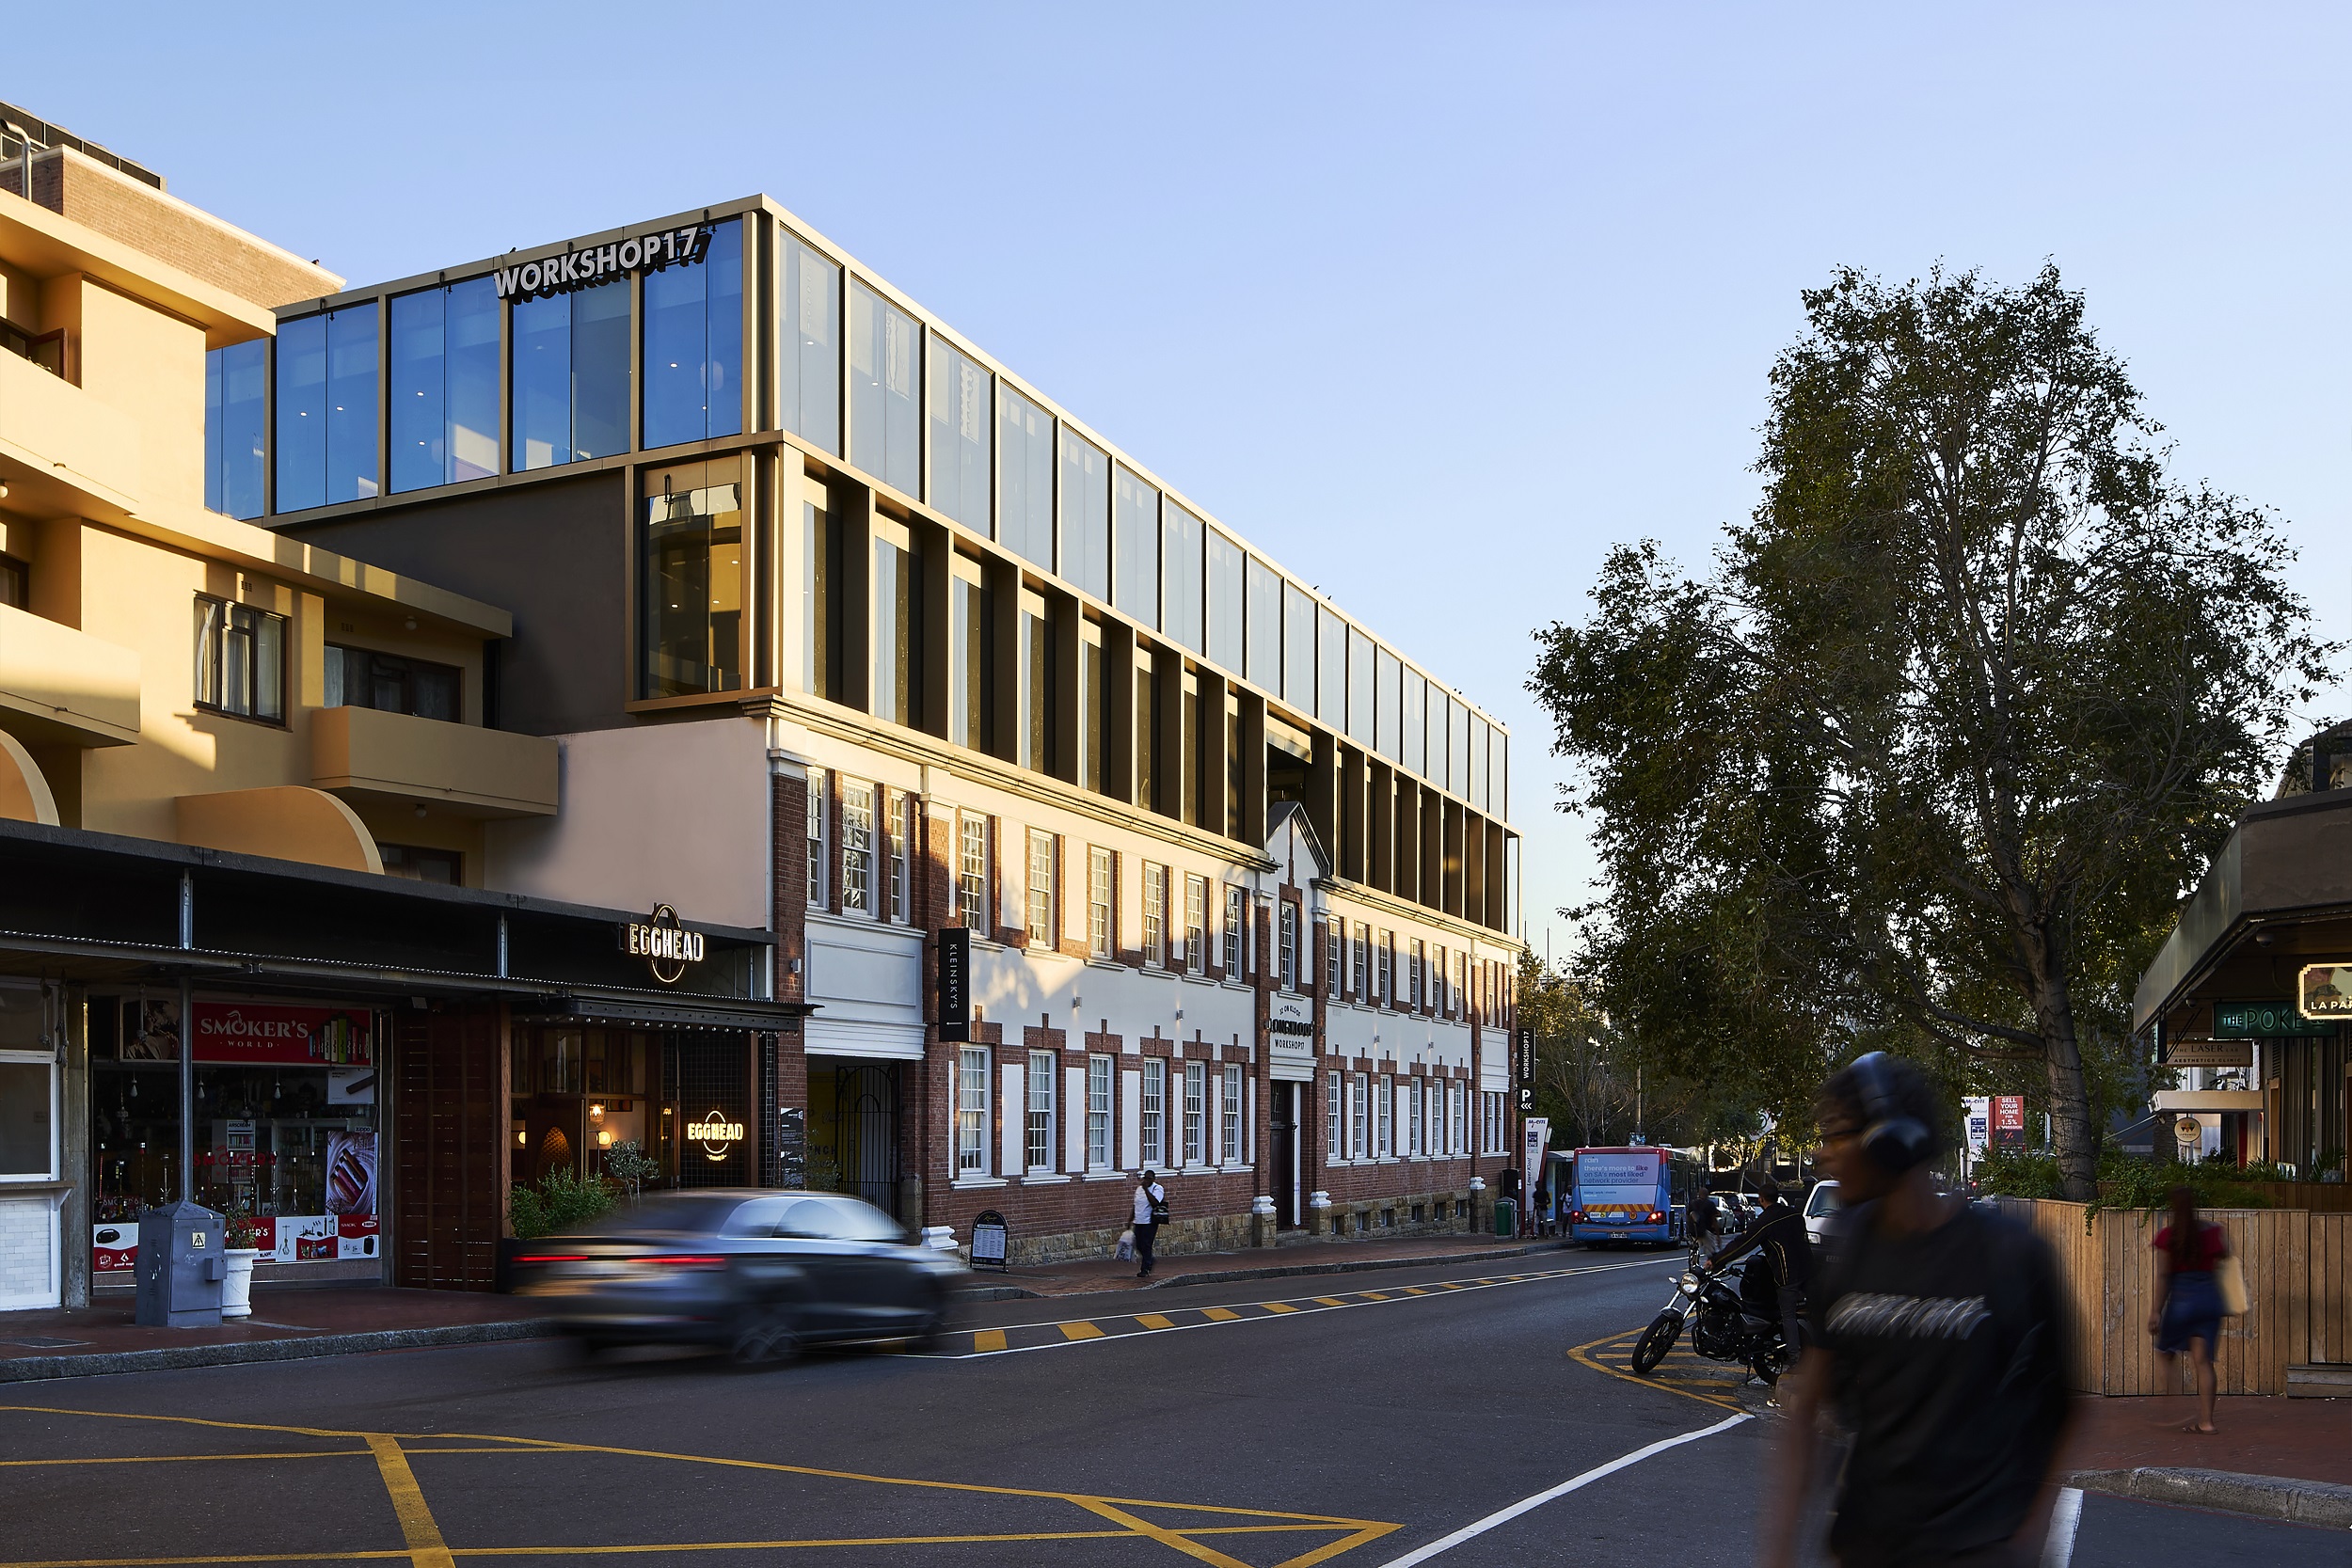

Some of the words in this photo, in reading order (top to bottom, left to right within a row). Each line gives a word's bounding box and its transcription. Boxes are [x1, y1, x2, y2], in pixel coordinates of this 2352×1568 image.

[494, 227, 697, 297] WORKSHOP17
[629, 923, 704, 961] EGGHEAD
[949, 943, 958, 1009] KLEINSKY'S
[2311, 1001, 2328, 1010] LA
[200, 1017, 309, 1038] SMOKER'S
[2223, 1015, 2244, 1025] THE
[1521, 1089, 1532, 1102] P
[688, 1122, 743, 1141] EGGHEAD
